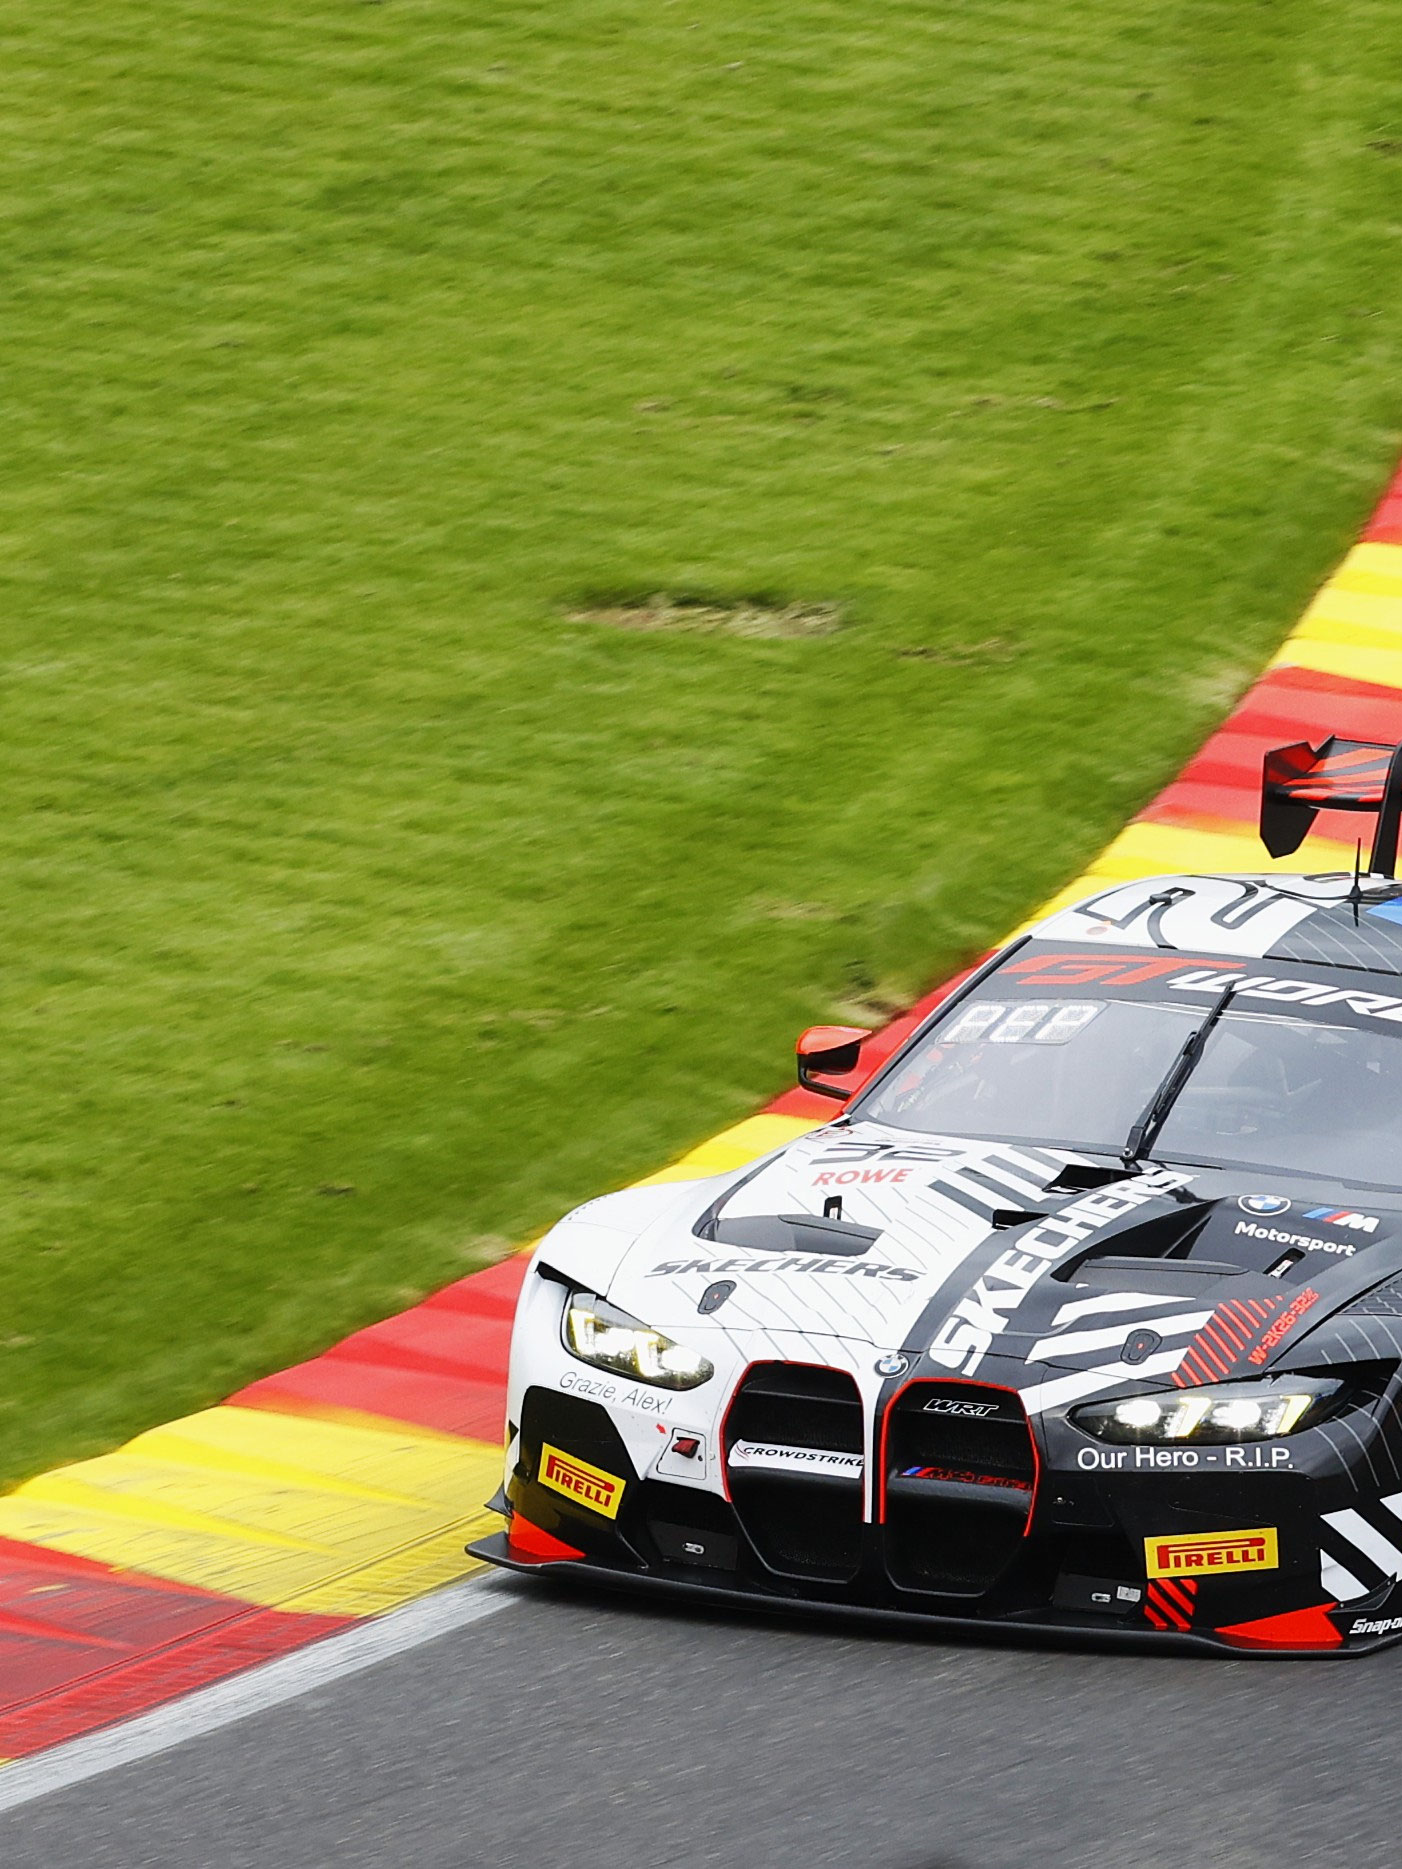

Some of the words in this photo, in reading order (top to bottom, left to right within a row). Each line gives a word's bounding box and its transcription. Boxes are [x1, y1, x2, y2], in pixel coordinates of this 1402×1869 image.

[1000, 953, 1247, 987] GT
[811, 1168, 914, 1187] ROWE
[1234, 1220, 1357, 1257] Motorsport
[644, 1257, 928, 1282] SKECHERS
[929, 1166, 1200, 1377] SKECHERS
[559, 1371, 617, 1402] Grazie,
[621, 1388, 673, 1415] Alex!
[923, 1398, 1000, 1417] WRT
[743, 1447, 864, 1467] CROWDSTRIKE
[1077, 1447, 1128, 1470] Our
[1135, 1446, 1199, 1468] Hero
[1225, 1447, 1294, 1469] R.I.P.
[545, 1454, 616, 1507] PIRELLI
[1156, 1537, 1266, 1570] PIRELLI
